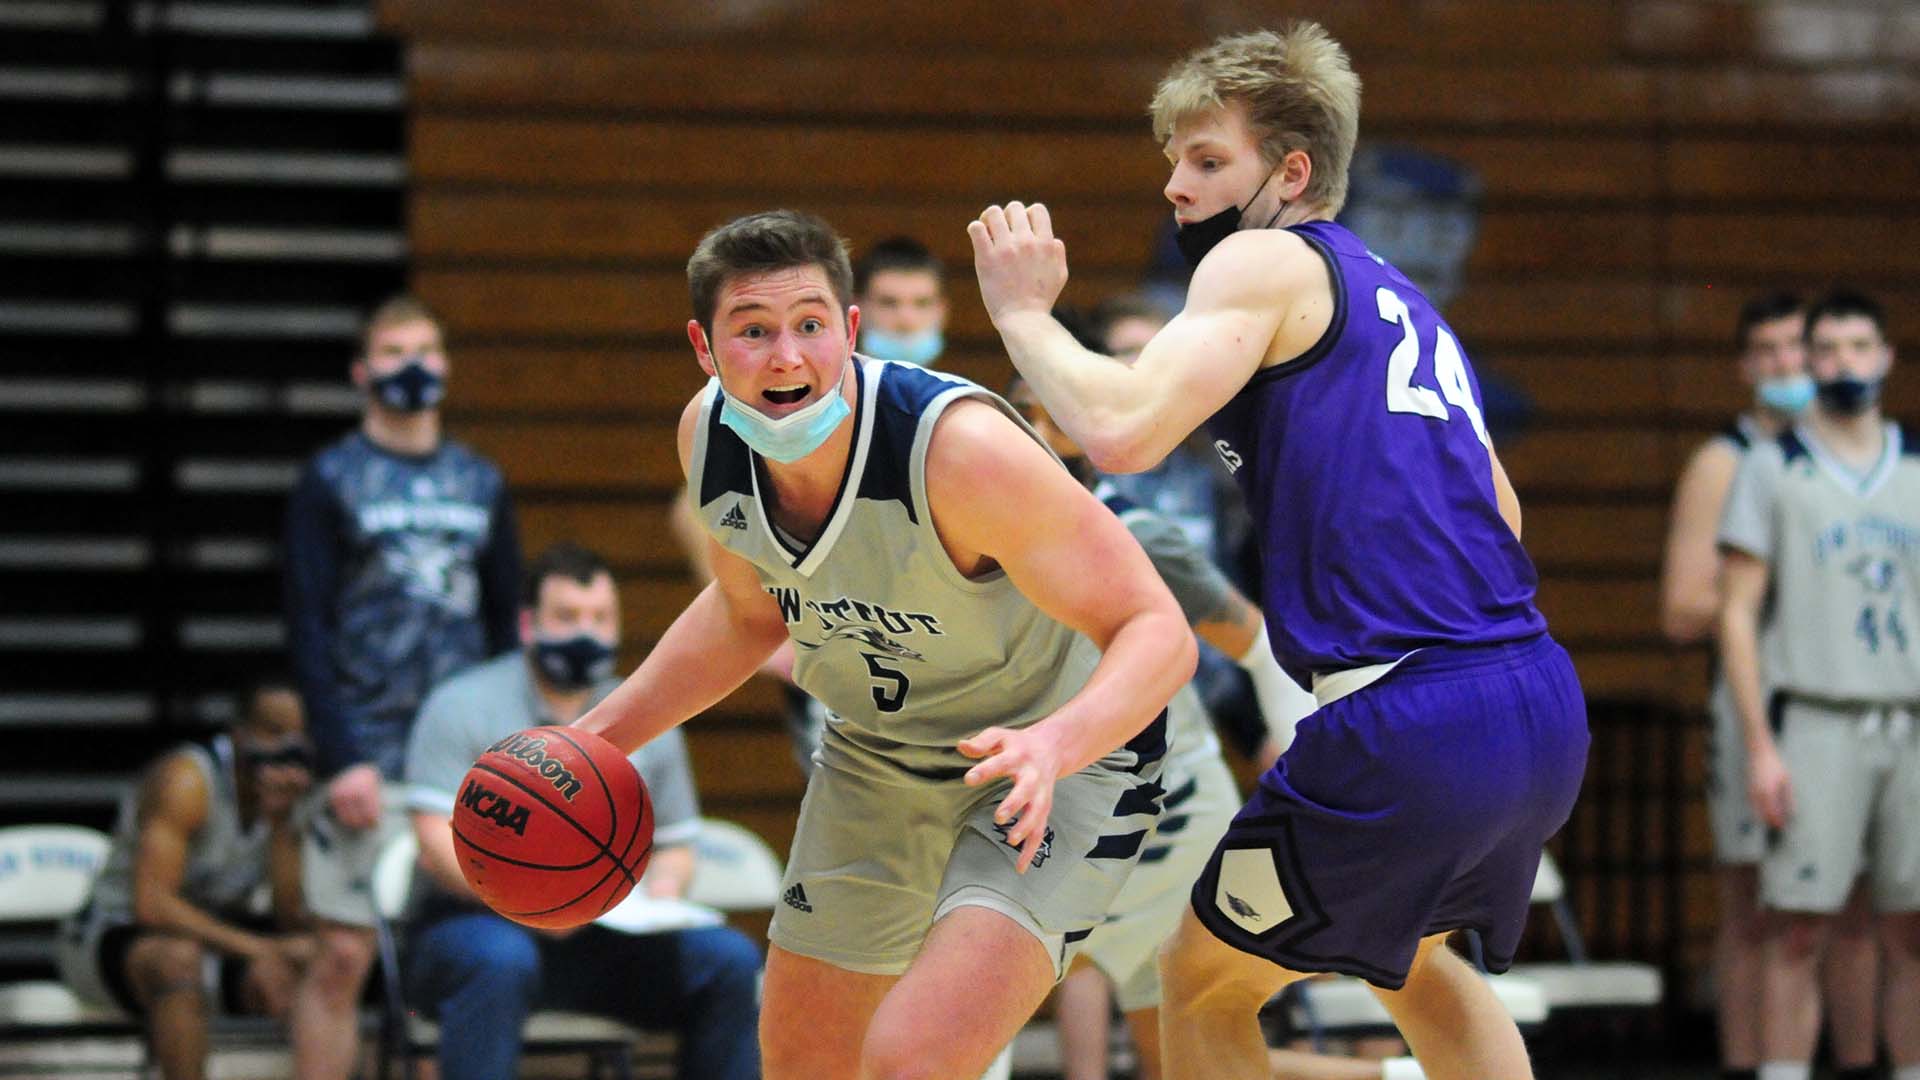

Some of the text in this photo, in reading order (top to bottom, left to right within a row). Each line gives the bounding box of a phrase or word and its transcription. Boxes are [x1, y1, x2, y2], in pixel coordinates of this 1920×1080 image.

[1375, 286, 1488, 450] 24
[767, 586, 803, 624] W
[858, 651, 911, 714] 5
[461, 779, 531, 836] NCAA
